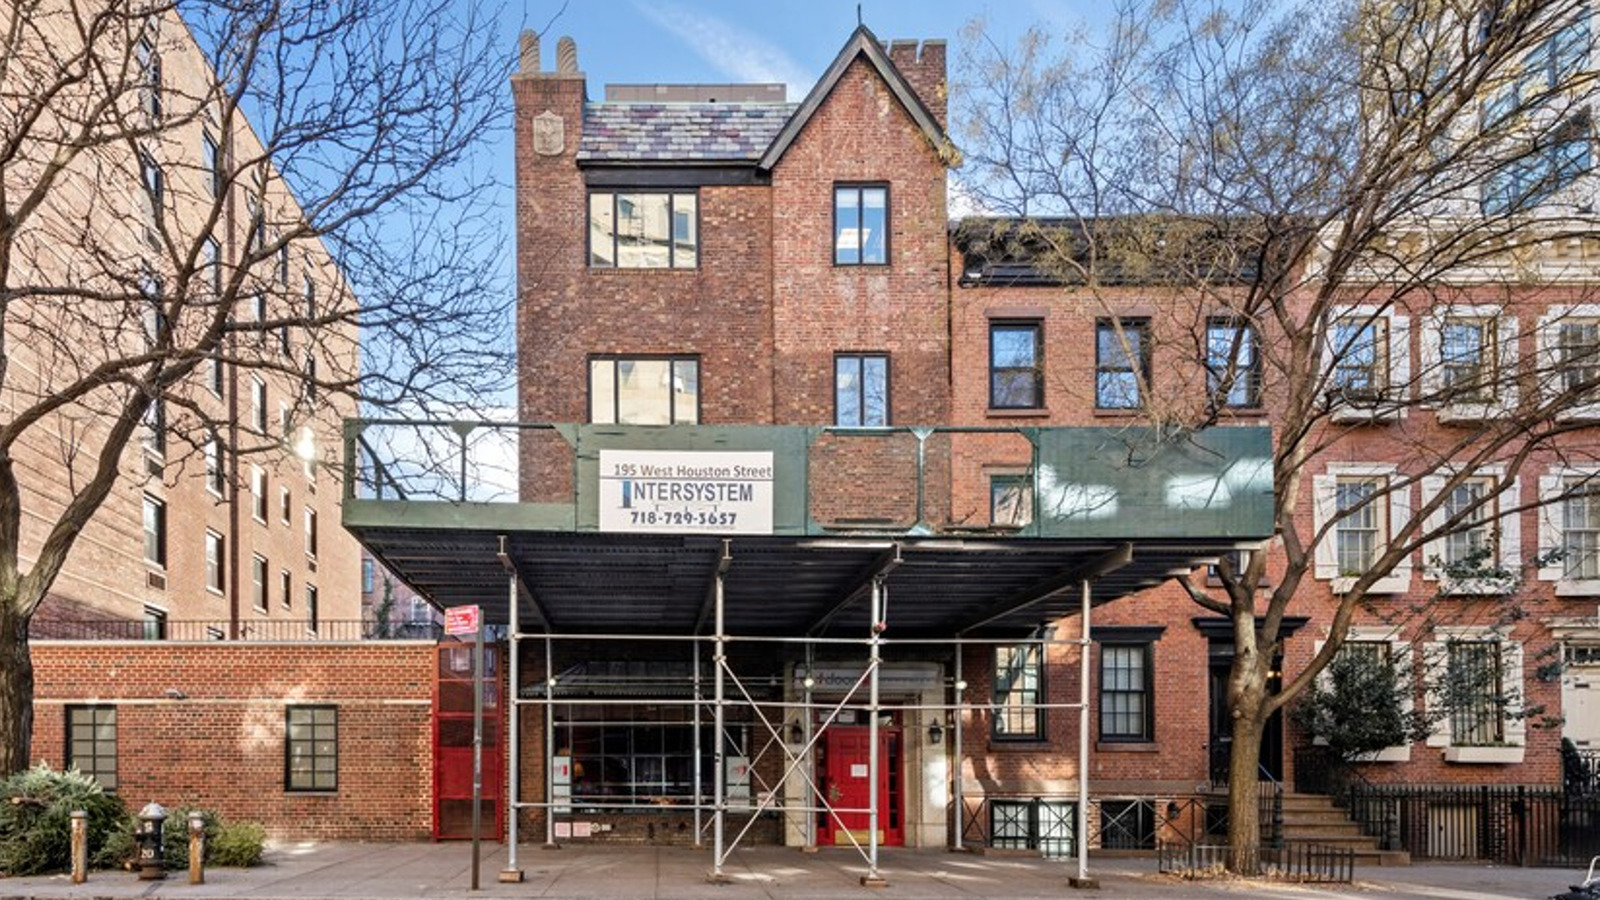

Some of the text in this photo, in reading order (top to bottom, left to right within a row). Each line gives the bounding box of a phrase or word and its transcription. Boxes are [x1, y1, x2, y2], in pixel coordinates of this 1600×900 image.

[614, 463, 772, 478] 195 West Houston Street
[630, 511, 737, 525] 718-729-3657
